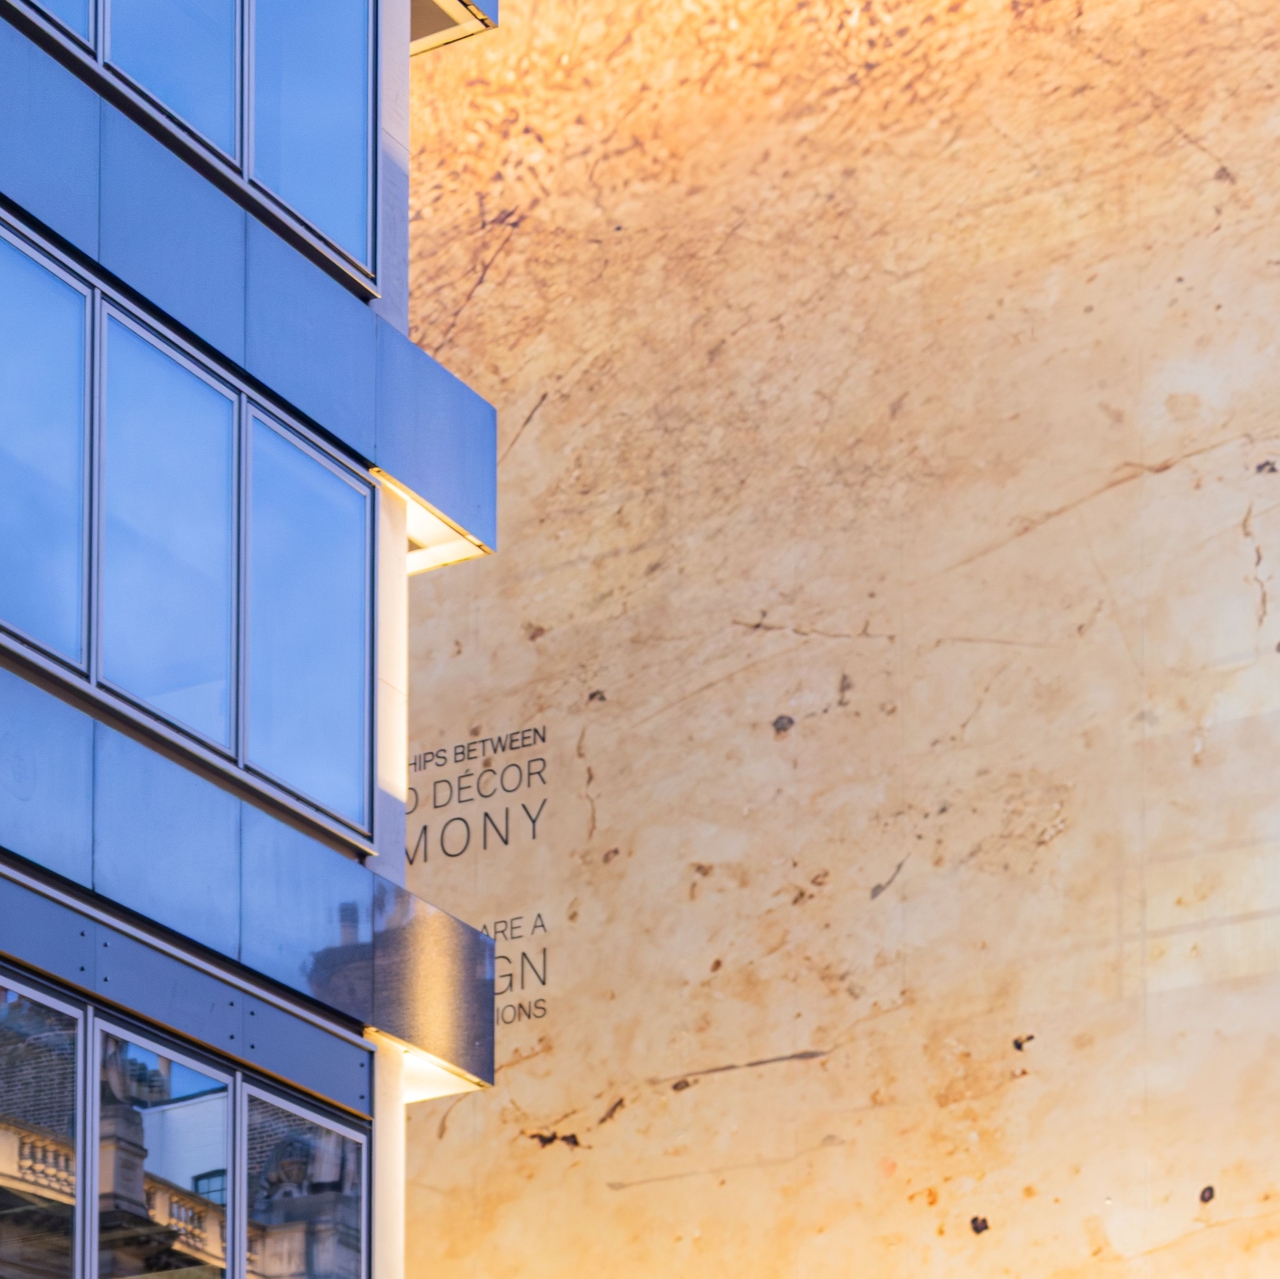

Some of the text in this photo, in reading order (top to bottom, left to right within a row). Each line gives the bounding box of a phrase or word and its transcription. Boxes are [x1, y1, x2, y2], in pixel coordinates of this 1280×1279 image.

[453, 725, 546, 763] BETWEEN
[433, 757, 547, 809] DÉCOR
[531, 912, 548, 936] A
[495, 998, 548, 1026] IONS
